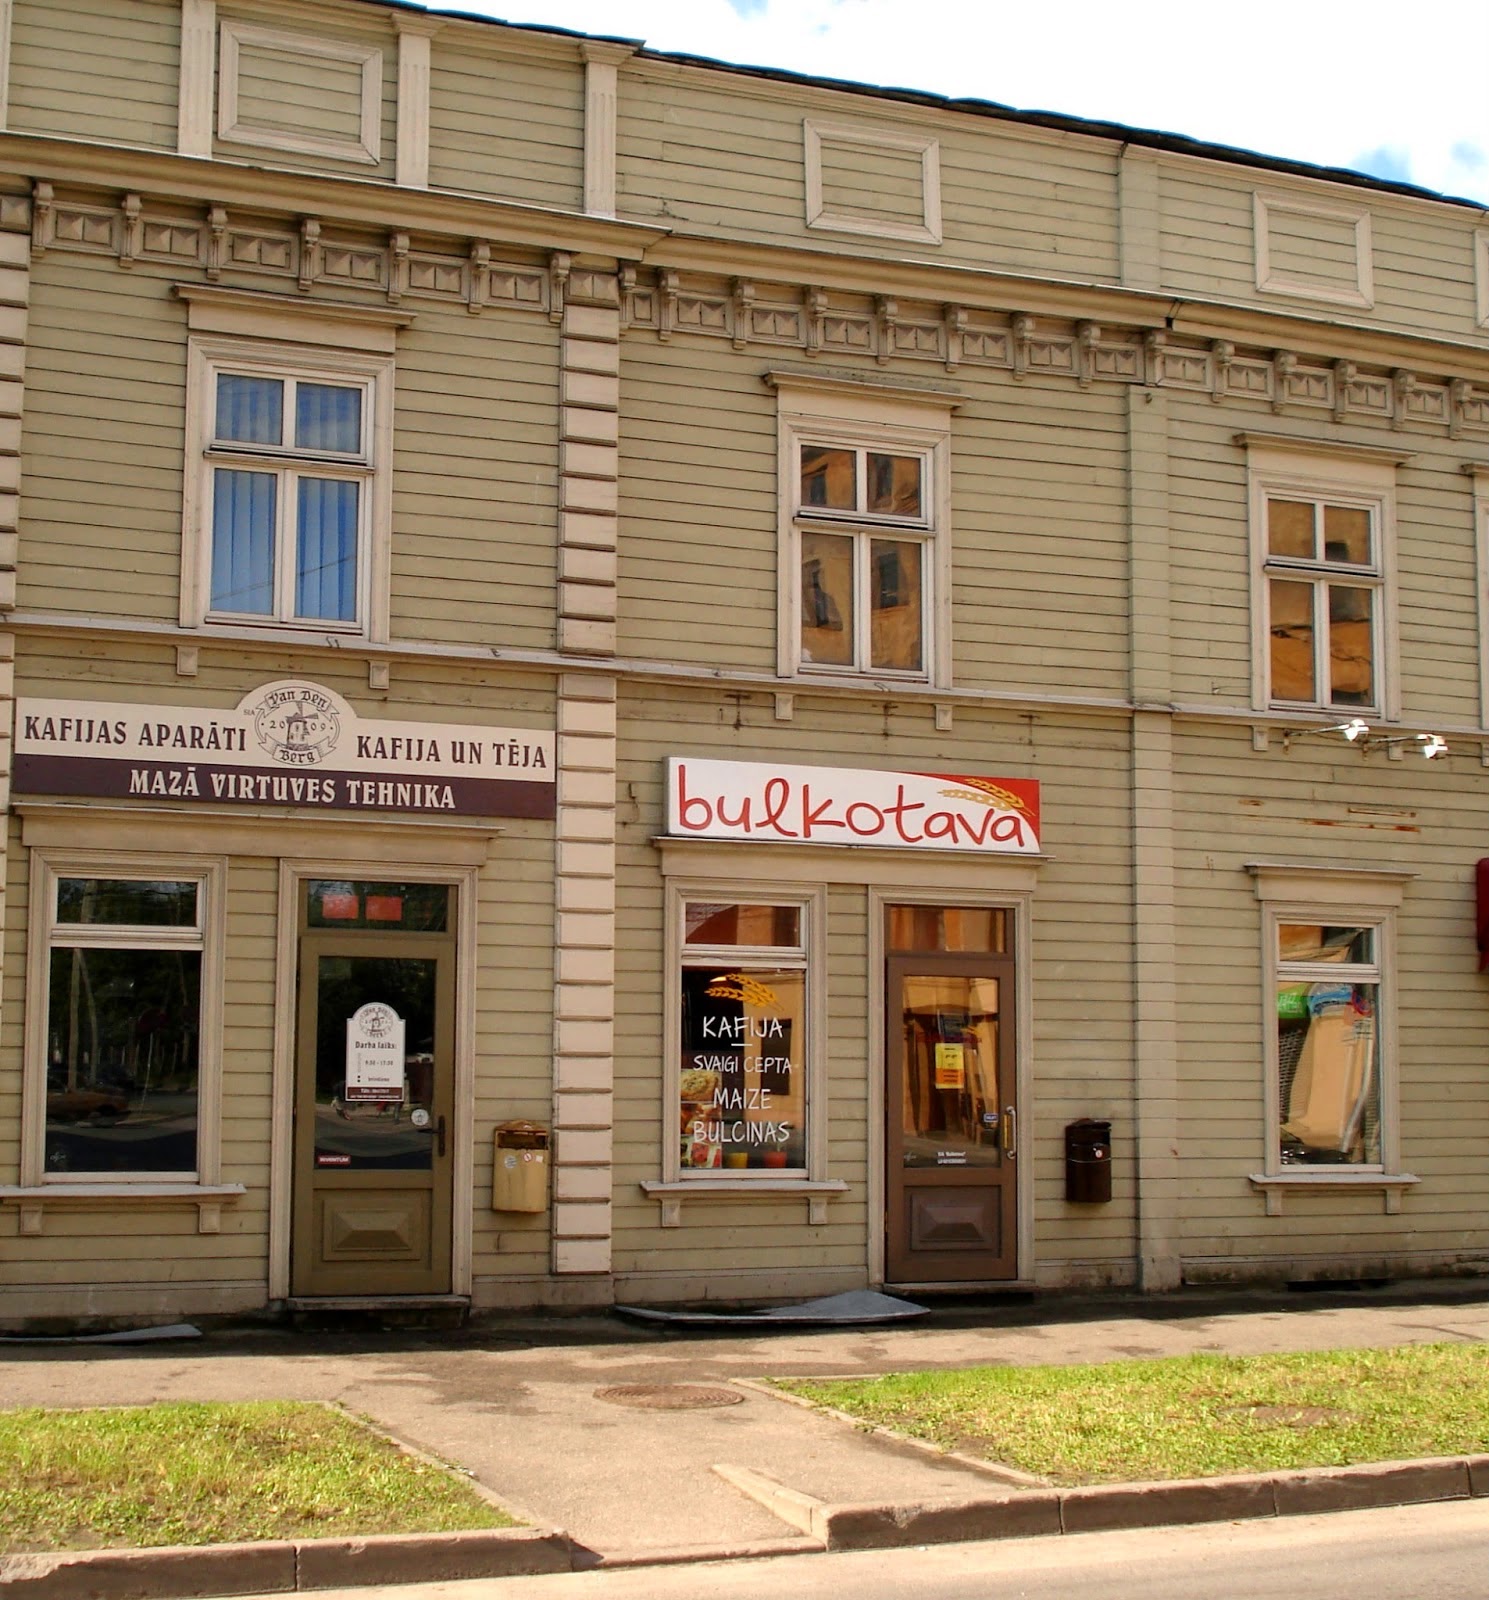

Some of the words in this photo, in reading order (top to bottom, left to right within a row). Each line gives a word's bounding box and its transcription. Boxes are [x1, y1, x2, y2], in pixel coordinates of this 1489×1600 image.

[269, 690, 296, 705] Van
[300, 690, 327, 708] Den
[243, 708, 256, 716] SIA
[24, 716, 127, 745] KAFIJAS
[138, 721, 247, 751] APARĀTI
[279, 749, 316, 763] Berg
[356, 735, 442, 762] KAFIJA
[451, 740, 483, 764] UN
[493, 738, 547, 769] TĒJA
[129, 766, 200, 797] MAZĀ
[210, 772, 336, 804] VIRTUVES
[346, 779, 456, 809] TEHNIKA
[678, 764, 1025, 848] bulkotava
[702, 1016, 783, 1039] KAFIJA
[355, 1041, 376, 1049] Darba
[693, 1054, 739, 1074] SVAIGI
[743, 1055, 793, 1074] CEPTA
[713, 1087, 773, 1110] MAIZE
[693, 1120, 790, 1147] BULCIŅAS
